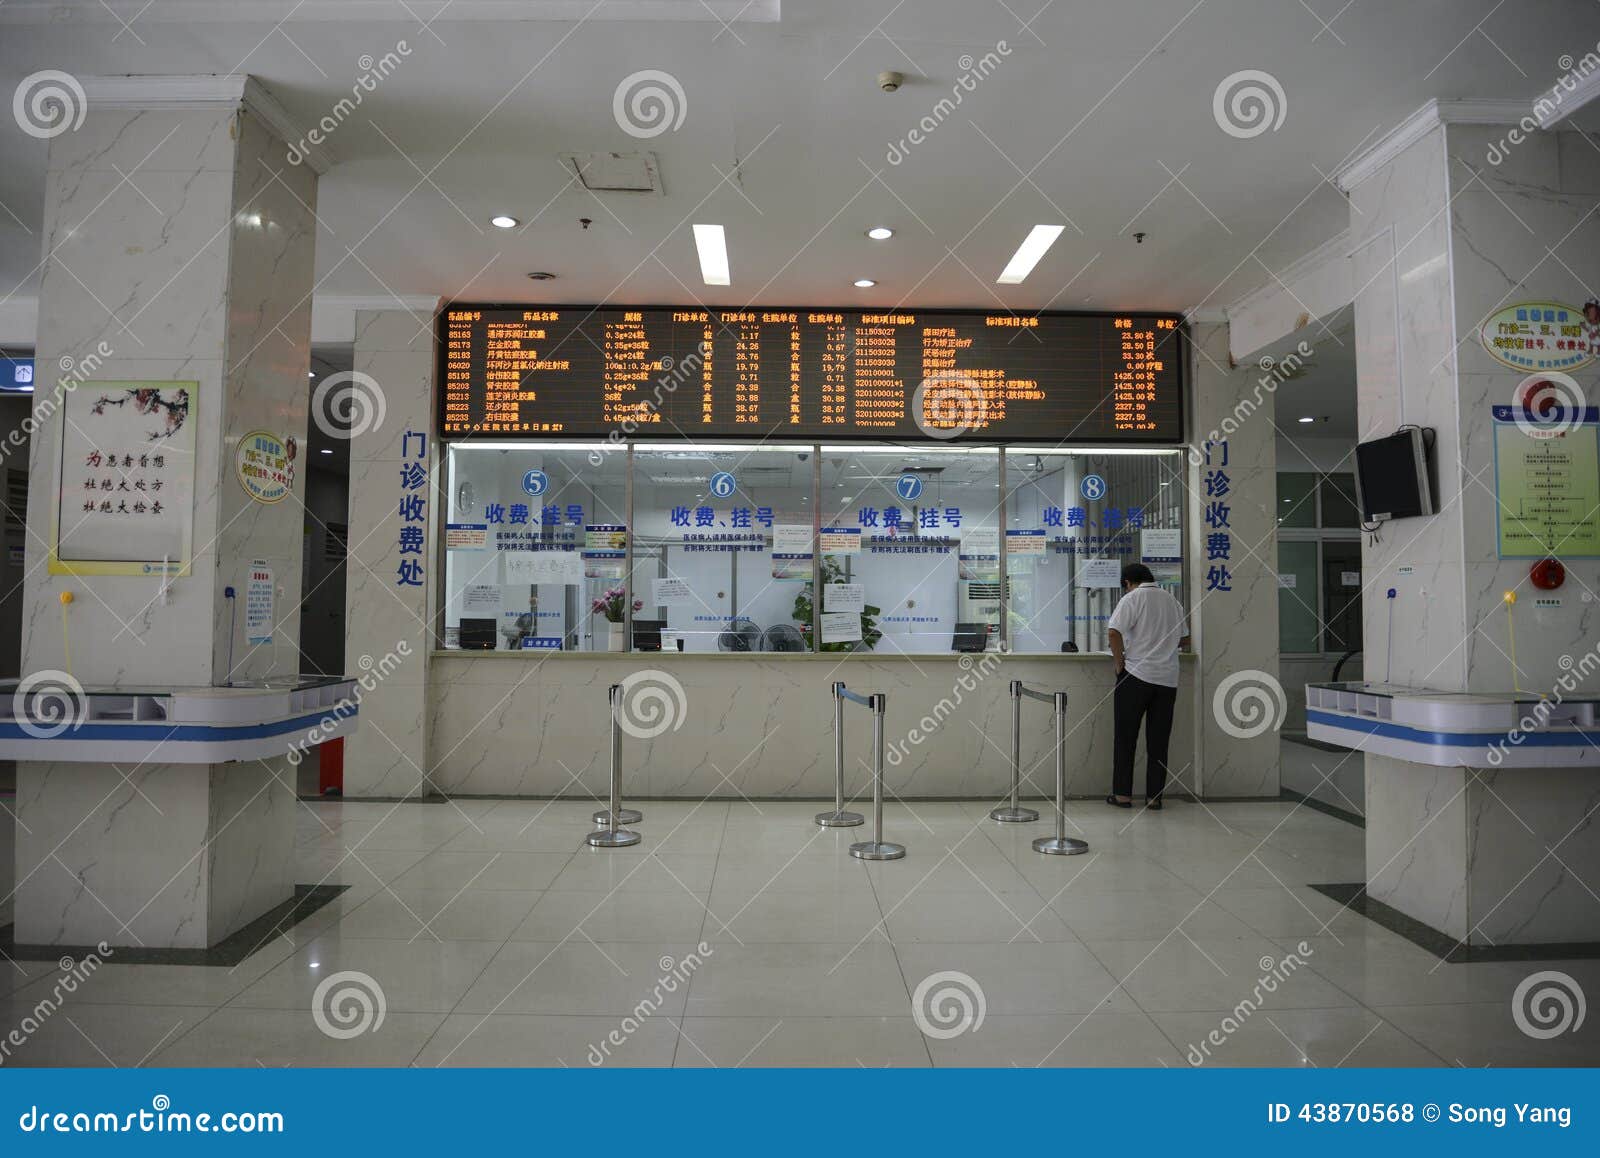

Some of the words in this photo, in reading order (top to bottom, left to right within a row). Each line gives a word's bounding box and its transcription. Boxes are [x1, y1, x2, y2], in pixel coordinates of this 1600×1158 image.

[523, 312, 559, 321] 药品名称
[624, 313, 643, 321] 规格
[673, 313, 709, 321] 门诊单位
[721, 313, 756, 322] 门诊单价
[761, 314, 798, 322] 住院单位
[807, 314, 844, 323] 住院单价
[861, 315, 916, 324] 标准项目编码
[985, 317, 1039, 326] 标准项目名称
[1114, 319, 1133, 328] 价格
[1156, 320, 1175, 328] 单位
[84, 477, 164, 491] 杜绝大处方
[83, 500, 165, 514] 杜绝大检查
[397, 431, 427, 586] 门诊收费处
[485, 503, 585, 525] 收费、挂号
[671, 506, 776, 528] 收费、挂号
[858, 506, 963, 528] 收费挂号
[1043, 506, 1145, 528] 收费、挂号
[1204, 440, 1233, 592] 门诊收费处
